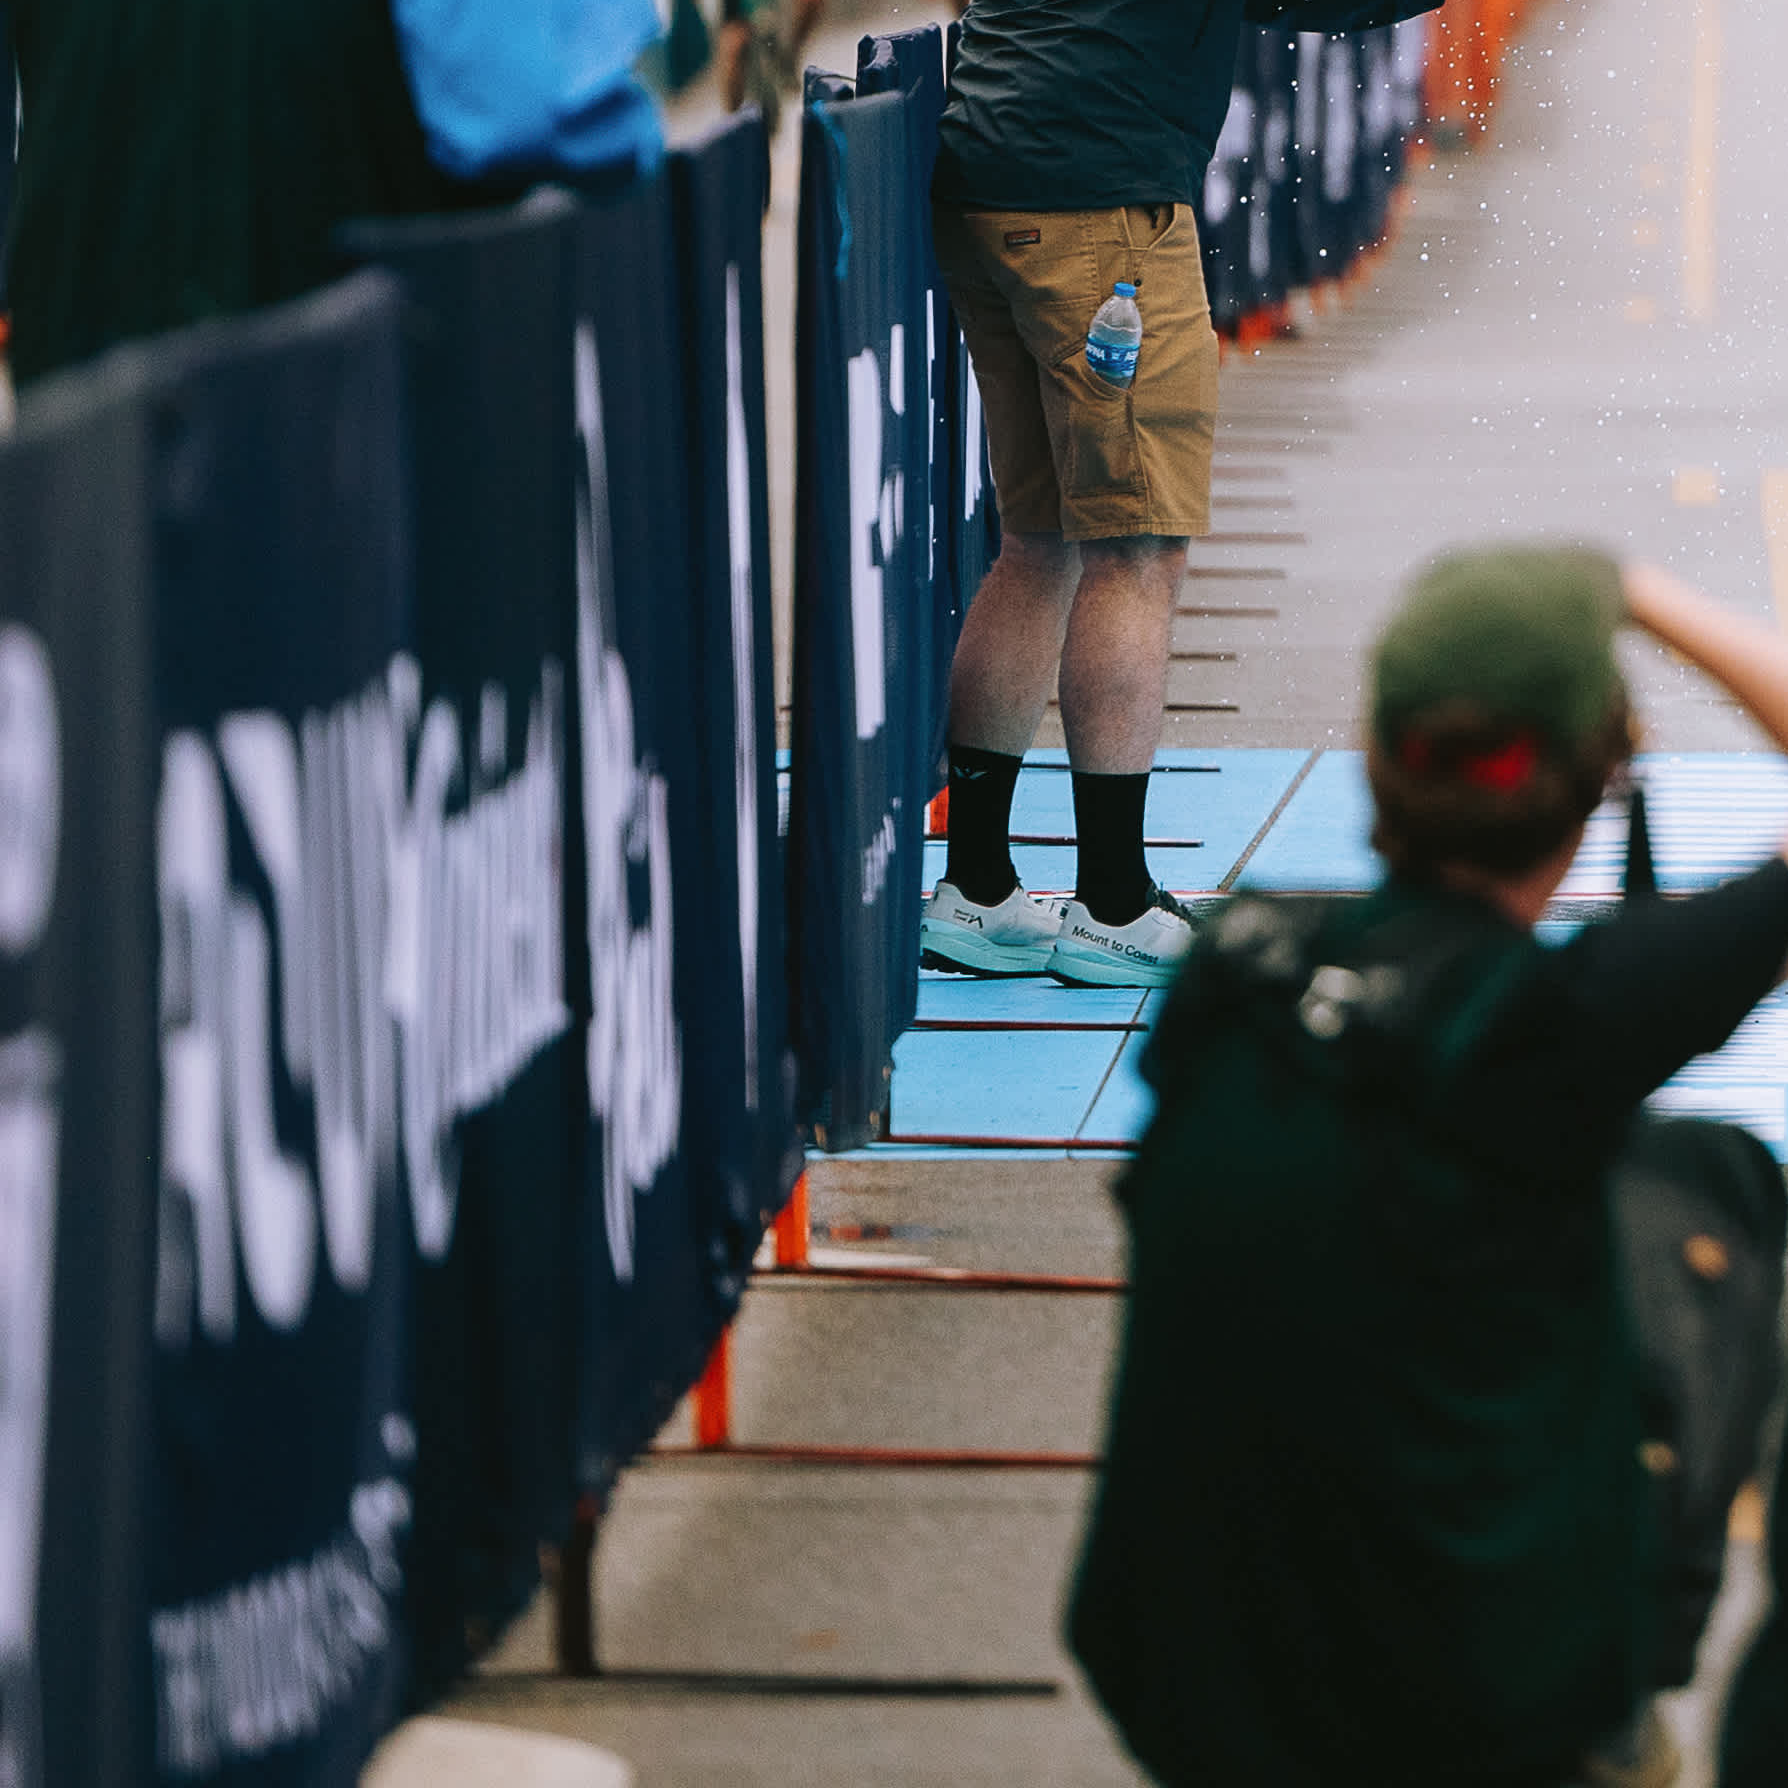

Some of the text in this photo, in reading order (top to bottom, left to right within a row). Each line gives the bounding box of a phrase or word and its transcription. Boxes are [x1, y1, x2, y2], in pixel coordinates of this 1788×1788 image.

[1071, 925, 1159, 965] Mount to Coast
